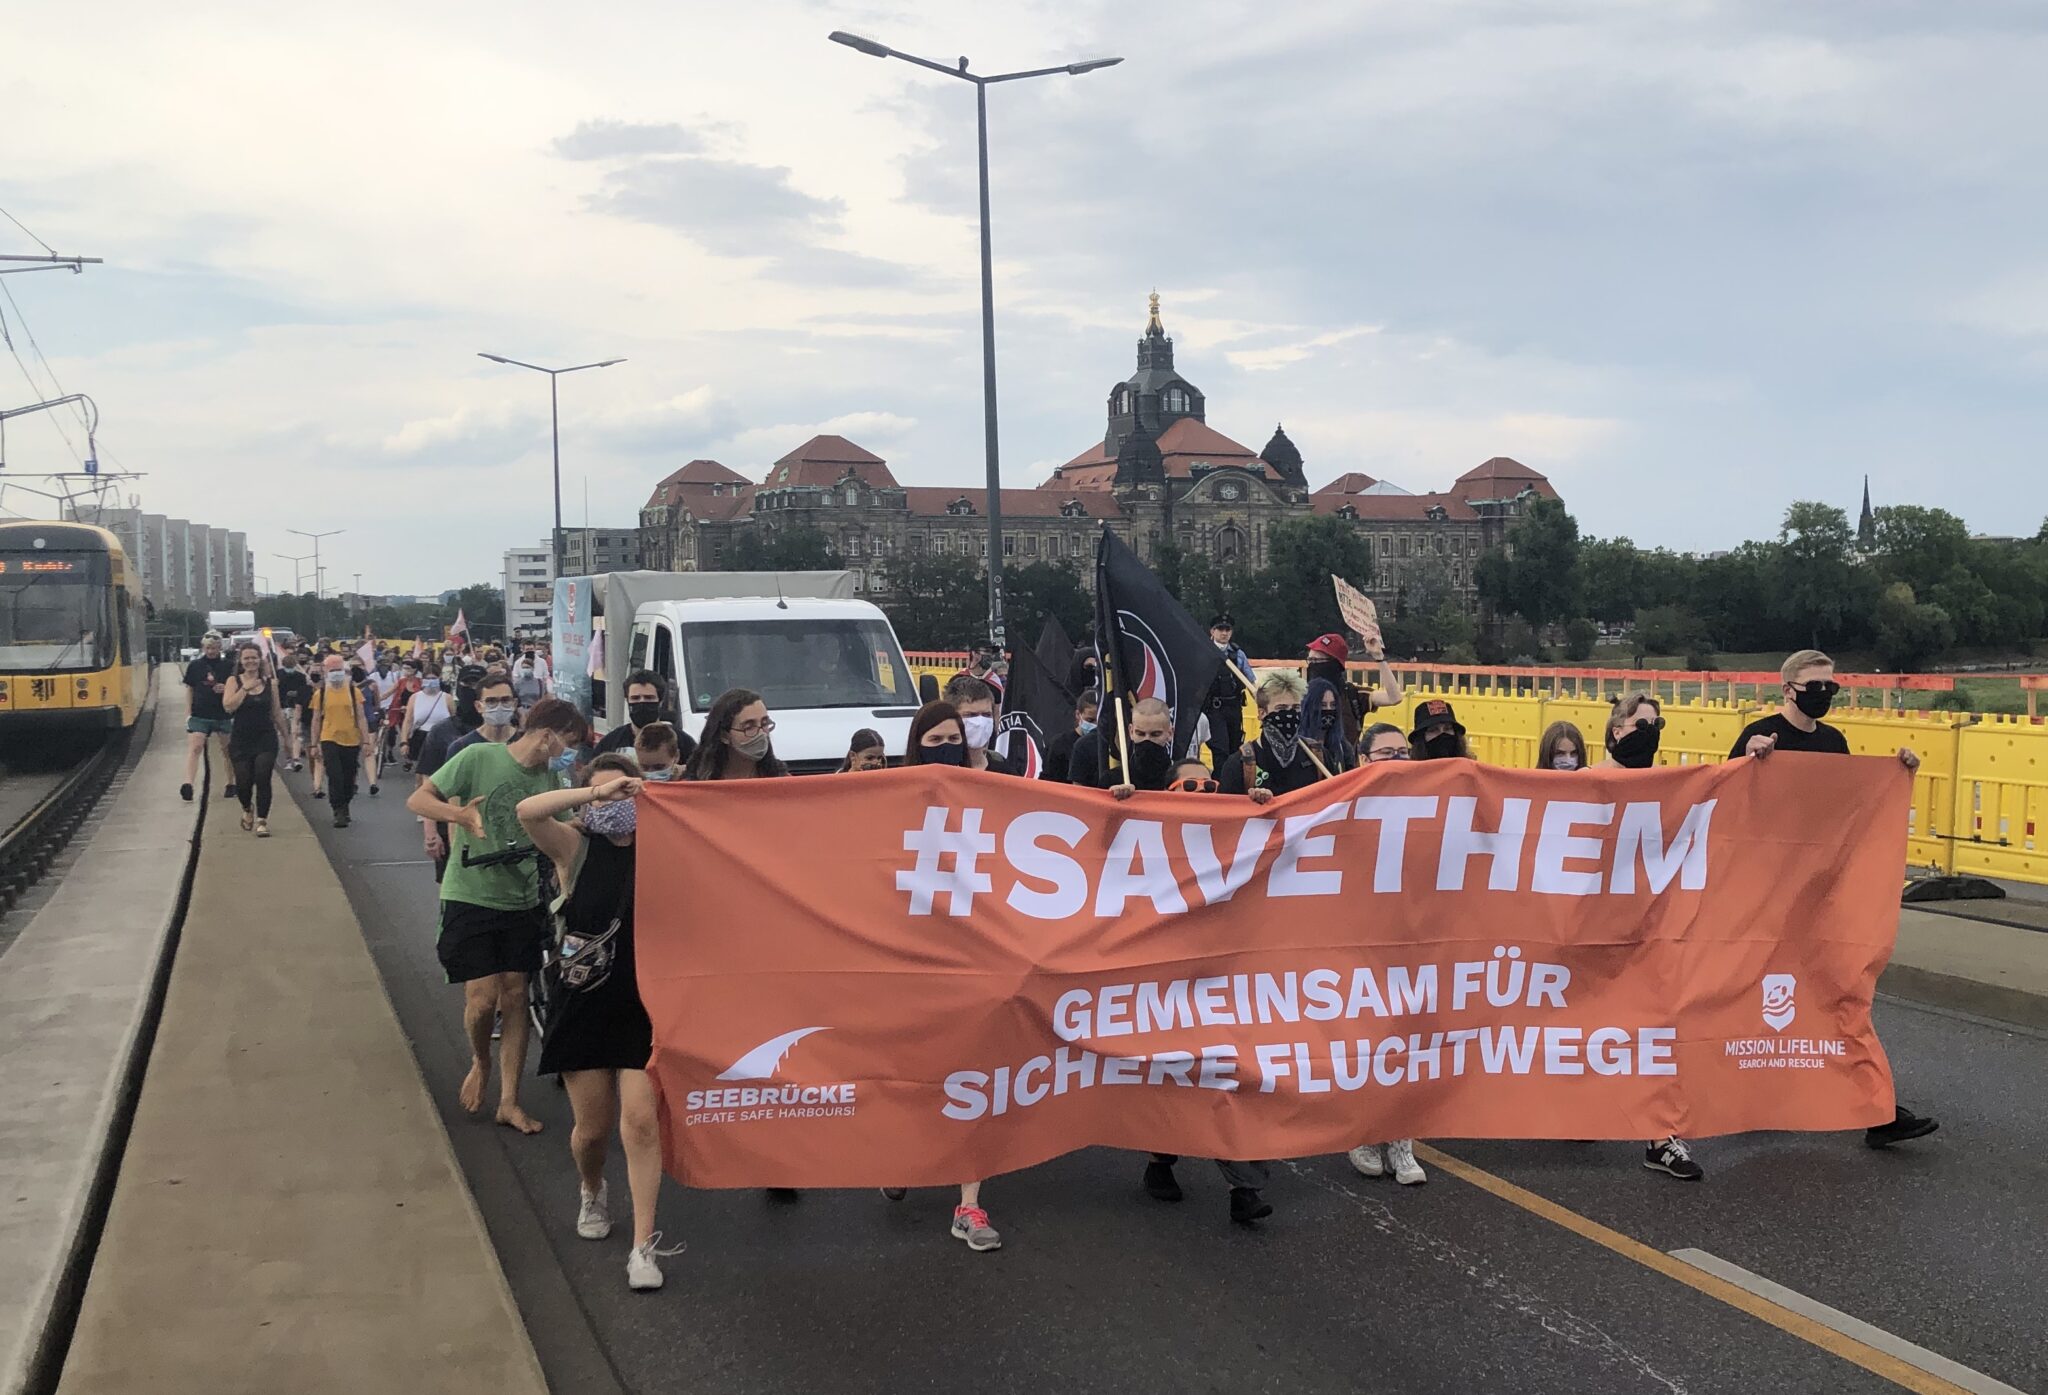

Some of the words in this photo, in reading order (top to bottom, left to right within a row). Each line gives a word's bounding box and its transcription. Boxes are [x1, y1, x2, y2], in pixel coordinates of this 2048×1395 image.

[896, 796, 1717, 919] #SAVETHEM
[1053, 965, 1438, 1043] GEMEINSAM
[1453, 946, 1571, 1009] FÜR
[1725, 1039, 1775, 1056] MISSION
[1779, 1039, 1846, 1056] LIFELINE
[942, 1044, 1240, 1120] SICHERE
[1258, 1026, 1678, 1094] FLUCHTWEGE
[1739, 1059, 1766, 1070] SEARCH
[1768, 1059, 1786, 1068] AND
[1789, 1058, 1825, 1069] RESCUE
[686, 1083, 856, 1110] SEEBRÜCKE
[686, 1112, 735, 1126] CREATE
[740, 1108, 774, 1122] SAFE
[778, 1106, 856, 1119] HARBOURS!
